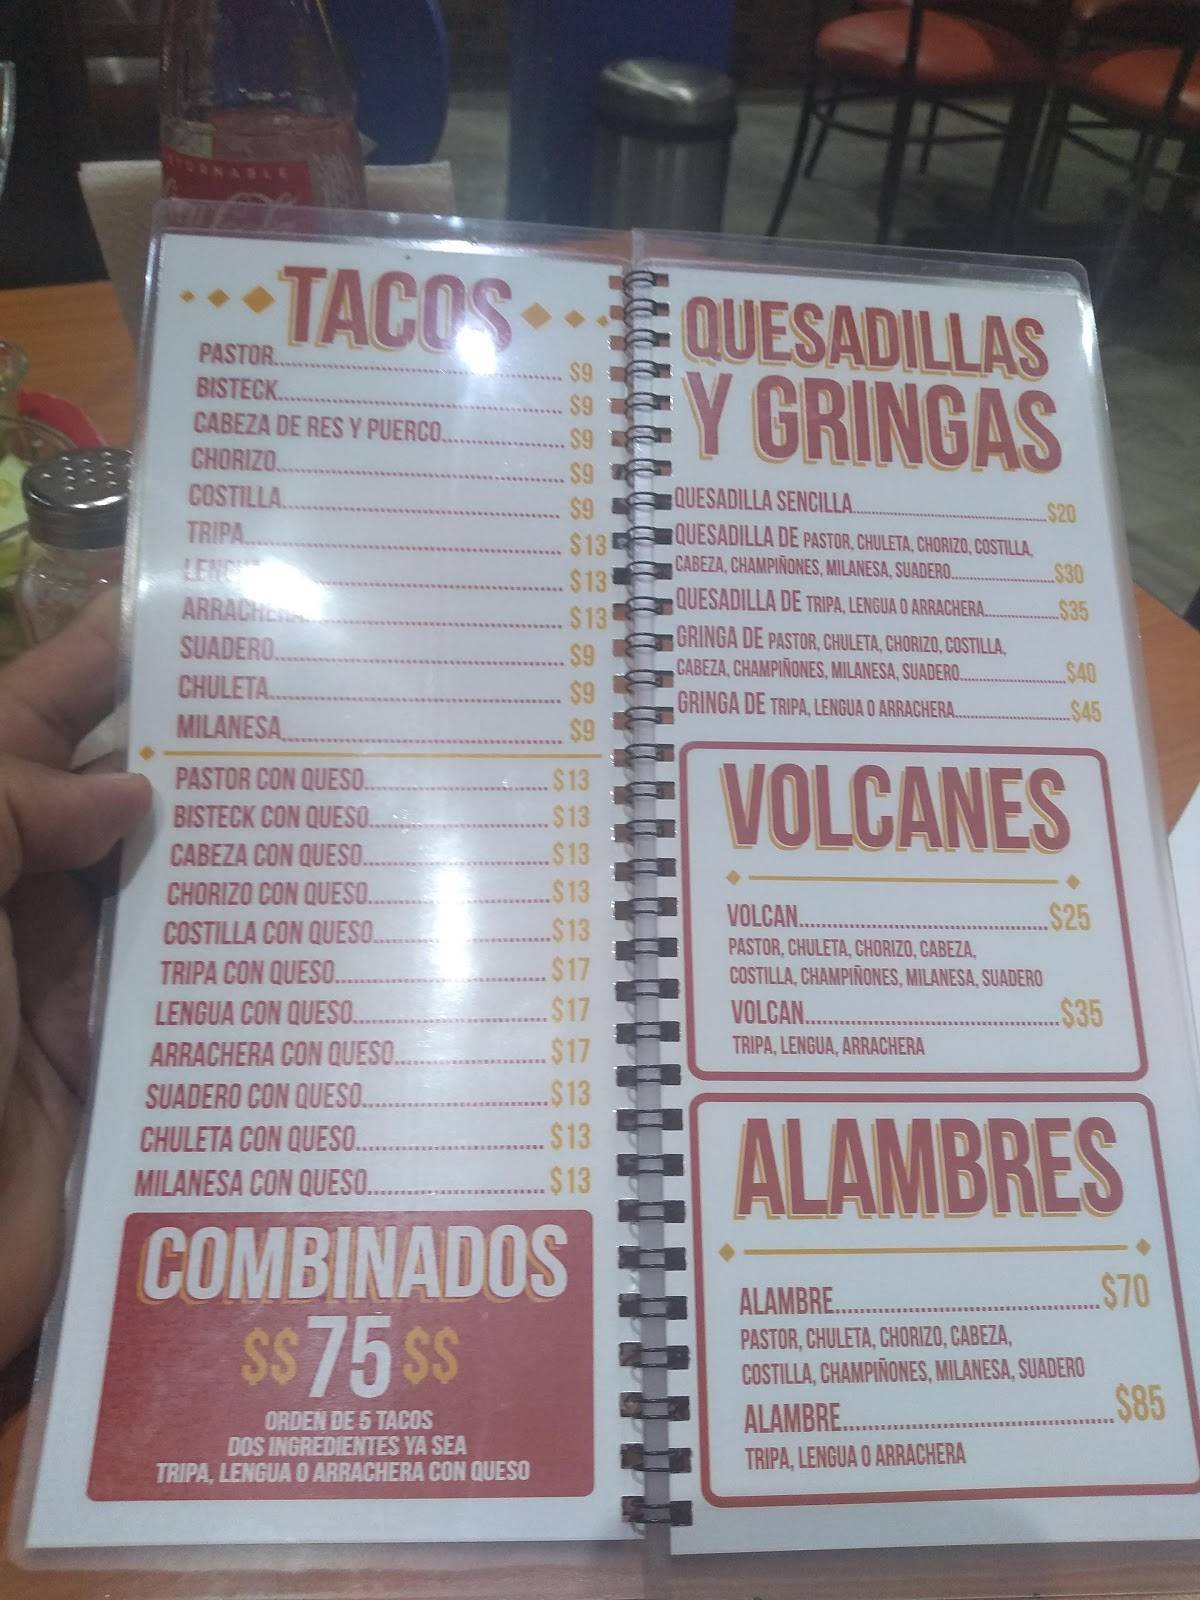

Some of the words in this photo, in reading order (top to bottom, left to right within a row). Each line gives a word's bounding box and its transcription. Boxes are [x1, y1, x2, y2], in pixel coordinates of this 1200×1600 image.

[278, 265, 513, 355] TACOS
[681, 295, 1049, 382] QUESADILLAS
[199, 342, 274, 366] PASTOR
[569, 363, 594, 383] $9
[196, 376, 278, 400] BISTECK
[569, 396, 594, 416] $9
[194, 412, 271, 436] CABEZA
[276, 415, 300, 437] DE
[307, 416, 343, 439] RES
[350, 418, 363, 438] Y
[368, 419, 443, 442] PUERCO
[570, 429, 594, 450] $9
[682, 371, 733, 460] Y
[753, 373, 1062, 475] GRINGAS
[191, 448, 277, 472] CHORIZO
[570, 464, 594, 485] $9
[189, 485, 282, 509] COSTILLA
[570, 499, 594, 520] $9
[674, 486, 773, 511] QUESADILLA
[777, 490, 853, 514] SENCILLA
[1047, 503, 1077, 524] $20
[185, 521, 245, 545] TRIPA
[570, 534, 607, 557] $13
[675, 523, 774, 548] QUESADILLA
[778, 526, 799, 548] DE
[803, 532, 854, 551] PASTOR,
[857, 534, 914, 553] CHULETA,
[917, 536, 972, 555] CHORIZO,
[975, 538, 1033, 558] COSTILLA,
[570, 570, 607, 593] $13
[675, 555, 727, 575] CABEZA,
[731, 556, 823, 578] CHAMPIÑONES,
[826, 560, 893, 579] MILANESA,
[895, 562, 951, 580] SUADERO
[1054, 563, 1084, 584] $30
[570, 607, 607, 630] $13
[675, 587, 776, 613] QUESADILLA
[780, 589, 801, 612] DE
[806, 595, 845, 615] TRIPA,
[849, 596, 896, 615] LENGUA
[900, 598, 908, 615] O
[911, 598, 984, 617] ARRACHERA
[1059, 600, 1089, 622] $35
[179, 635, 274, 661] SUADERO
[570, 645, 595, 667] $9
[676, 625, 738, 650] GRINGA
[742, 627, 764, 649] DE
[768, 632, 821, 652] PASTOR,
[824, 633, 882, 653] CHULETA,
[885, 635, 942, 654] CHORIZO,
[945, 636, 1007, 656] COSTILLA,
[677, 658, 730, 678] CABEZA,
[733, 658, 828, 680] CHAMPIÑONES,
[831, 662, 900, 681] MILANESA,
[902, 663, 960, 682] SUADERO
[1066, 662, 1097, 684] $40
[178, 675, 268, 699] CHULETA
[570, 682, 595, 704] $9
[677, 691, 740, 716] GRINGA
[744, 692, 766, 716] DE
[770, 698, 811, 717] TRIPA,
[814, 699, 863, 717] LENGUA
[867, 700, 876, 717] O
[879, 700, 954, 719] ARRACHERA
[1071, 700, 1102, 723] $45
[176, 715, 282, 740] MILANESA
[570, 719, 595, 742] $9
[175, 767, 251, 790] PASTOR
[256, 768, 297, 790] CON
[302, 768, 365, 792] QUESO
[552, 768, 590, 792] $13
[173, 805, 255, 828] BISTECK
[261, 805, 301, 828] CON
[305, 806, 370, 830] QUESO
[552, 805, 590, 828] $13
[720, 762, 1072, 856] VOLCANES
[170, 844, 247, 867] CABEZA
[253, 843, 294, 867] CON
[299, 843, 363, 868] QUESO
[552, 843, 591, 866] $13
[167, 882, 252, 906] CHORIZO
[258, 882, 298, 905] CON
[303, 882, 369, 907] QUESO
[552, 880, 591, 904] $13
[727, 904, 799, 928] VOLCAN
[1049, 902, 1091, 931] $25
[163, 921, 256, 945] COSTILLA
[262, 921, 303, 945] CON
[308, 921, 373, 946] QUESO
[552, 919, 591, 943] $13
[728, 938, 785, 958] PASTOR,
[788, 938, 852, 958] CHULETA,
[855, 939, 917, 959] CHORIZO,
[920, 940, 977, 959] CABEZA,
[160, 960, 218, 985] TRIPA
[223, 960, 264, 984] CON
[269, 960, 336, 985] QUESO
[552, 958, 590, 982] $17
[729, 967, 798, 987] COSTILLA,
[800, 964, 903, 988] CHAMPIÑONES,
[906, 968, 979, 988] MILANESA,
[981, 969, 1043, 987] SUADERO
[154, 1001, 234, 1026] LENGUA
[241, 1001, 282, 1025] CON
[287, 1000, 353, 1025] QUESO
[551, 997, 590, 1023] $17
[731, 999, 805, 1025] VOLCAN
[1061, 997, 1104, 1028] $35
[149, 1042, 275, 1067] ARRACHERA
[281, 1041, 323, 1067] CON
[328, 1041, 394, 1067] QUESO
[551, 1038, 591, 1064] $17
[732, 1035, 777, 1056] TRIPA,
[781, 1035, 839, 1056] LENGUA,
[842, 1036, 925, 1056] ARRACHERA
[145, 1083, 242, 1110] SUADERO
[248, 1083, 290, 1109] CON
[295, 1082, 362, 1109] QUESO
[551, 1080, 591, 1107] $13
[140, 1126, 233, 1153] CHULETA
[239, 1126, 282, 1152] CON
[287, 1125, 356, 1152] QUESO
[550, 1122, 591, 1150] $13
[134, 1169, 243, 1197] MILANESA
[250, 1169, 293, 1196] CON
[299, 1168, 368, 1196] QUESO
[550, 1166, 591, 1194] $13
[734, 1117, 1124, 1220] ALAMBRES
[137, 1224, 569, 1304] COMBINADOS
[739, 1286, 834, 1316] ALAMBRE
[1101, 1273, 1150, 1310] $70
[740, 1327, 803, 1351] PASTOR,
[806, 1326, 877, 1349] CHULETA,
[879, 1325, 948, 1348] CHORIZO,
[951, 1325, 1013, 1347] CABEZA,
[307, 1315, 392, 1399] 75
[741, 1362, 817, 1386] COSTILLA,
[820, 1357, 933, 1384] CHAMPIÑONES,
[935, 1358, 1015, 1382] MILANESA,
[1018, 1357, 1085, 1379] SUADERO
[265, 1411, 326, 1431] ORDEN
[331, 1411, 355, 1431] DE
[359, 1411, 371, 1430] 5
[377, 1411, 433, 1431] TACOS
[744, 1403, 842, 1433] ALAMBRE
[1115, 1383, 1166, 1423] $85
[228, 1436, 264, 1457] DOS
[269, 1436, 400, 1457] INGREDIENTES
[404, 1435, 429, 1456] YA
[433, 1435, 467, 1456] SEA
[745, 1446, 795, 1471] TRIPA,
[799, 1445, 856, 1469] LENGUA
[861, 1444, 872, 1466] O
[875, 1441, 967, 1467] ARRACHERA
[156, 1463, 214, 1485] TRIPA,
[218, 1462, 291, 1484] LENGUA
[295, 1462, 309, 1483] O
[313, 1462, 424, 1483] ARRACHERA
[429, 1462, 466, 1482] CON
[471, 1461, 531, 1482] QUESO
